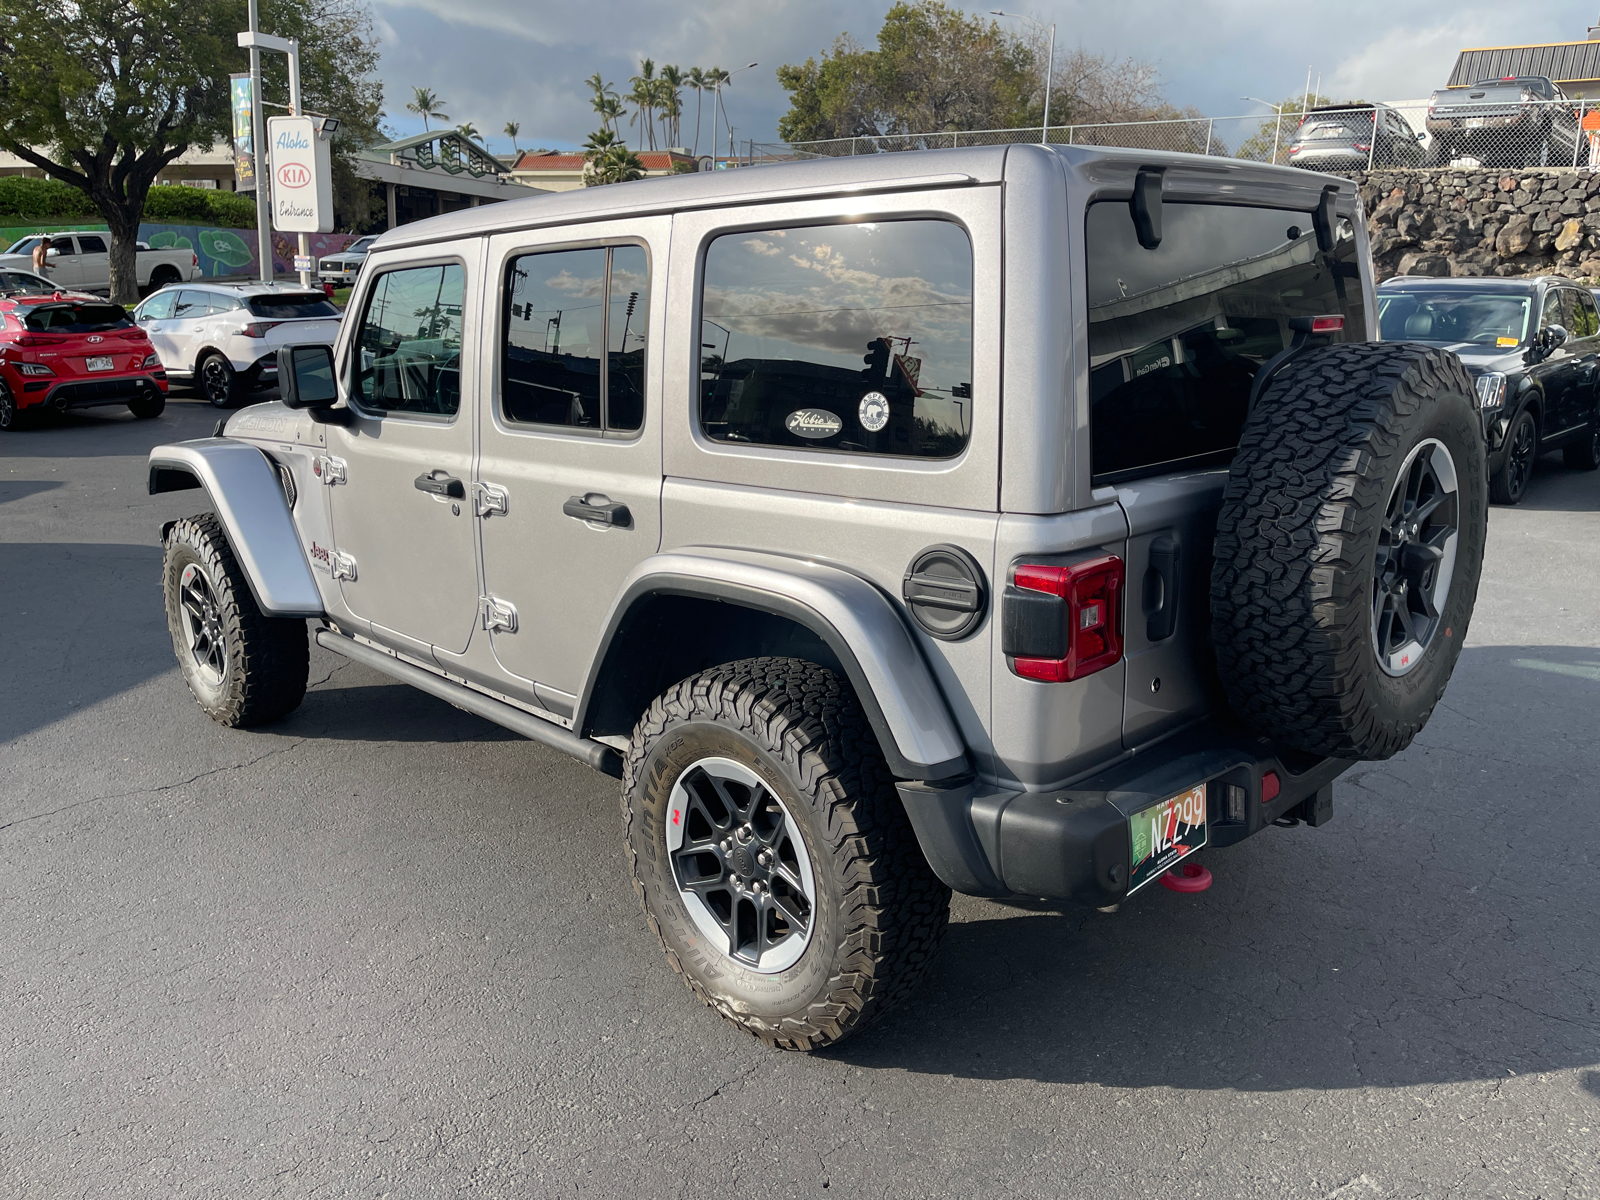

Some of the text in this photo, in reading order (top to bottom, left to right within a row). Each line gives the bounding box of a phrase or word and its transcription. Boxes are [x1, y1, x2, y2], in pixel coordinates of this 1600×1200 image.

[276, 131, 309, 149] Aloha
[283, 169, 306, 183] KIA
[279, 200, 314, 217] Entrance
[863, 393, 887, 407] ASPEN
[790, 411, 824, 427] Hobie
[861, 416, 885, 430] COLORADO
[1151, 791, 1203, 858] NZ299
